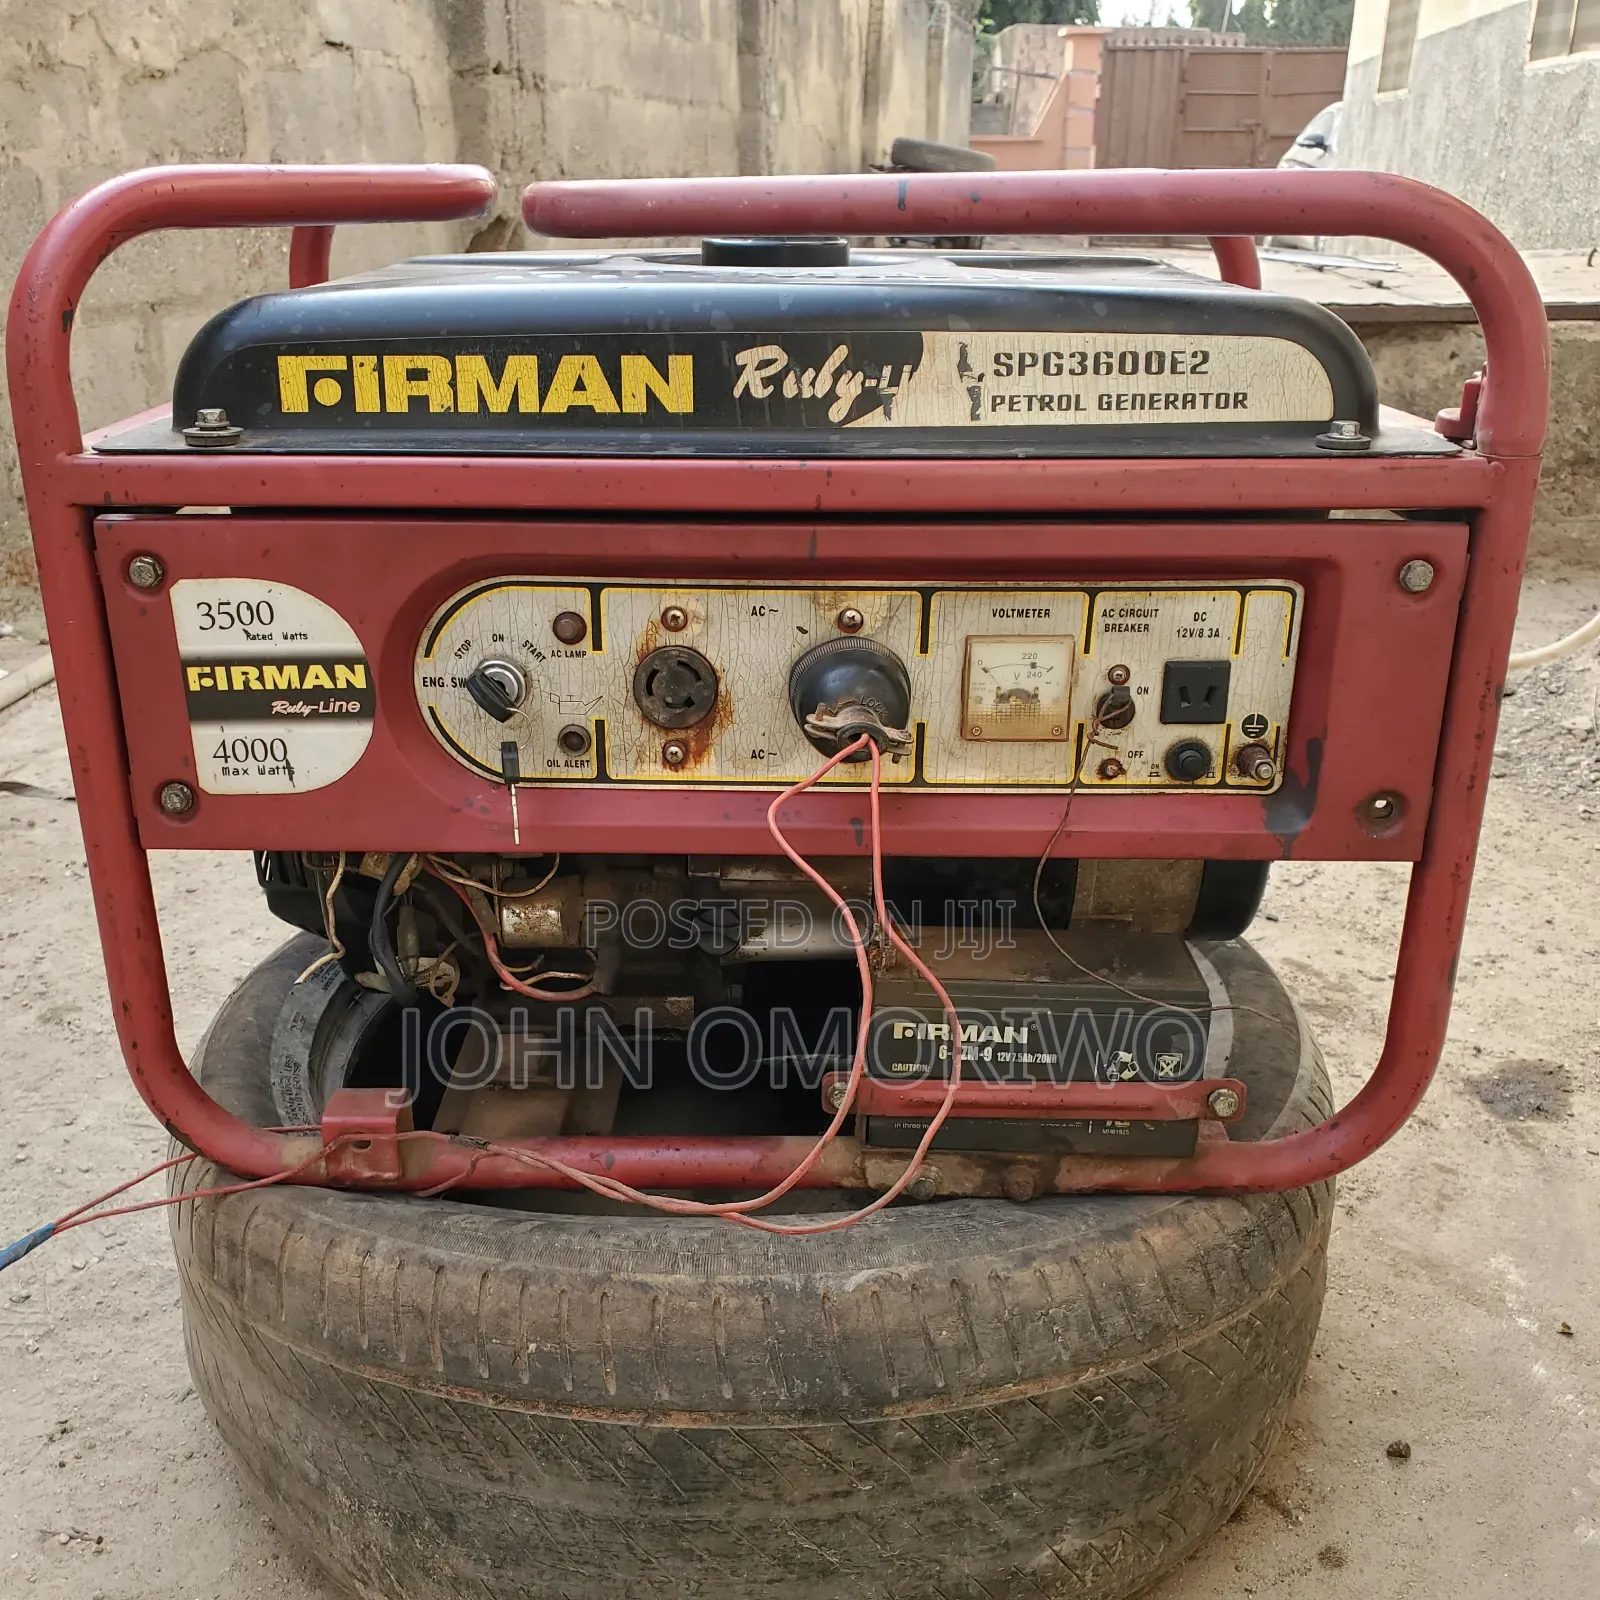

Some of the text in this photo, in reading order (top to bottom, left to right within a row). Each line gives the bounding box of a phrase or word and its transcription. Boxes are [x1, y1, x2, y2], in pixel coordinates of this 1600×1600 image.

[993, 349, 1210, 377] SPG3600E2
[277, 354, 694, 414] FIRMAN
[991, 392, 1248, 412] PETROL GENERATOR
[196, 600, 274, 630] 3500
[992, 608, 1051, 618] VOLTMETER
[1101, 609, 1114, 618] AC
[1193, 612, 1207, 622] DC
[1104, 623, 1149, 633] BREAKER
[1176, 627, 1220, 638] 12V/8.3A
[245, 631, 308, 641] Rated Watts
[491, 633, 504, 642] ON
[454, 639, 473, 660] STOP
[521, 639, 547, 663] START
[551, 650, 587, 659] AC LAMP
[1022, 652, 1038, 660] 220
[186, 664, 367, 691] FIRMAN
[1027, 671, 1043, 679] 240
[422, 676, 448, 688] ENG.
[1136, 686, 1149, 695] ON
[271, 698, 361, 717] Ruby-Line
[860, 694, 888, 717] LOCK
[212, 737, 288, 764] 4000
[1127, 750, 1144, 759] OFF
[546, 759, 591, 768] OIL ALERT
[221, 766, 250, 776] Max
[891, 1062, 931, 1073] CAUTION:
